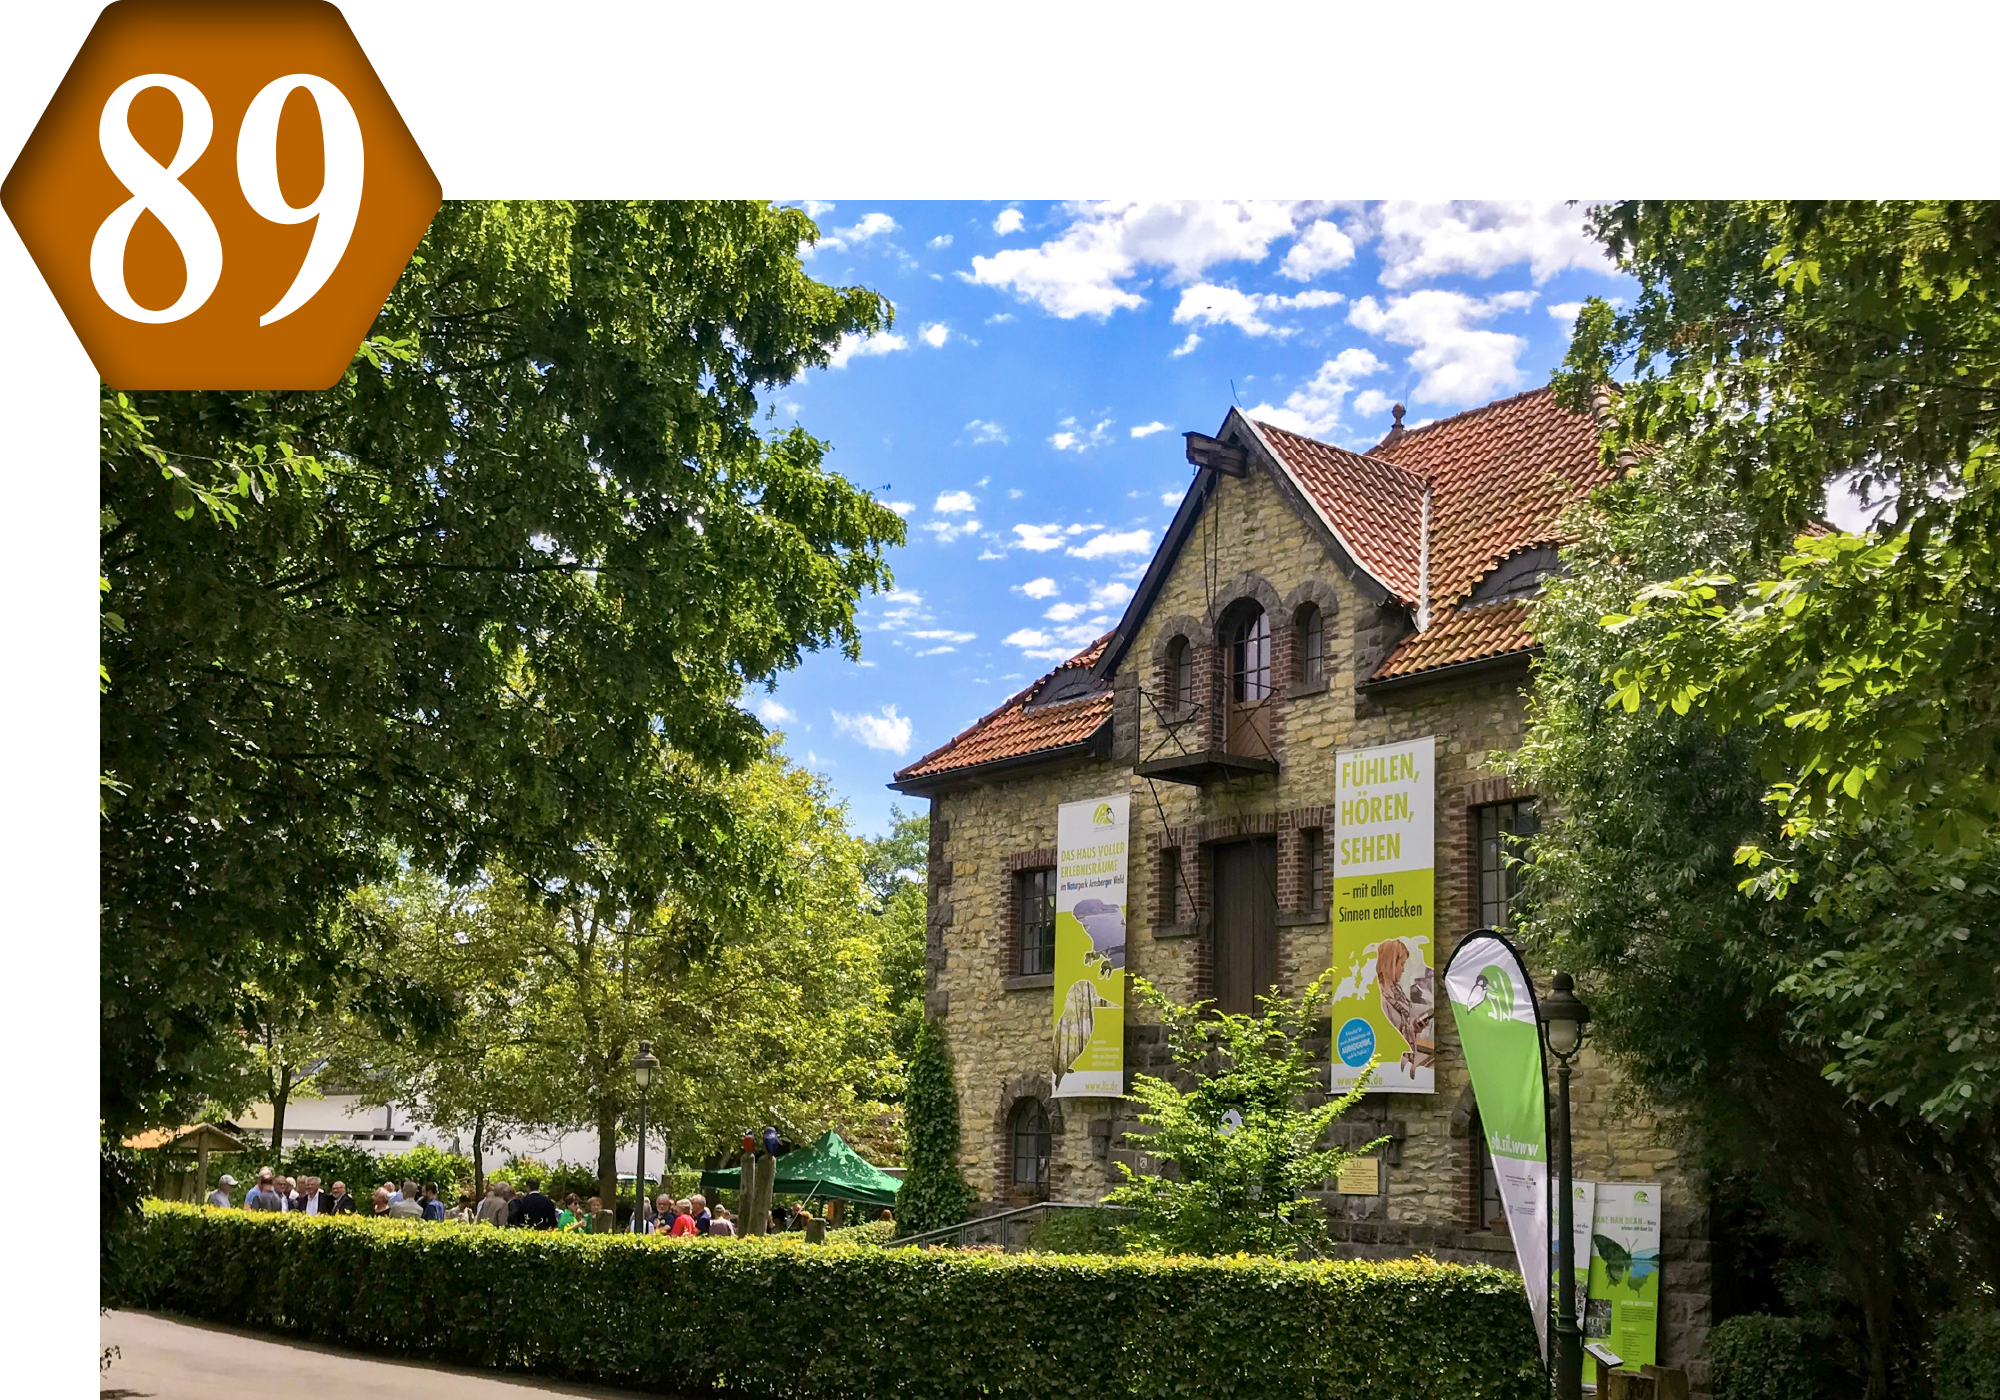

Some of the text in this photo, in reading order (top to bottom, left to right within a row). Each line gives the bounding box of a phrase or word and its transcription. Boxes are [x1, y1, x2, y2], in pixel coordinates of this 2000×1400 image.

[1342, 752, 1420, 788] FÜHLEN,
[1341, 791, 1415, 826] HÖREN,
[1061, 842, 1125, 862] DAS HAUS VOLLER
[1340, 832, 1400, 866] SEHEN
[1061, 859, 1118, 878] ERLEBNISRÄUME
[1067, 879, 1088, 891] Naturpark
[1352, 882, 1368, 899] mit
[1370, 879, 1394, 898] allen
[1338, 900, 1422, 923] Sinnen entdecken
